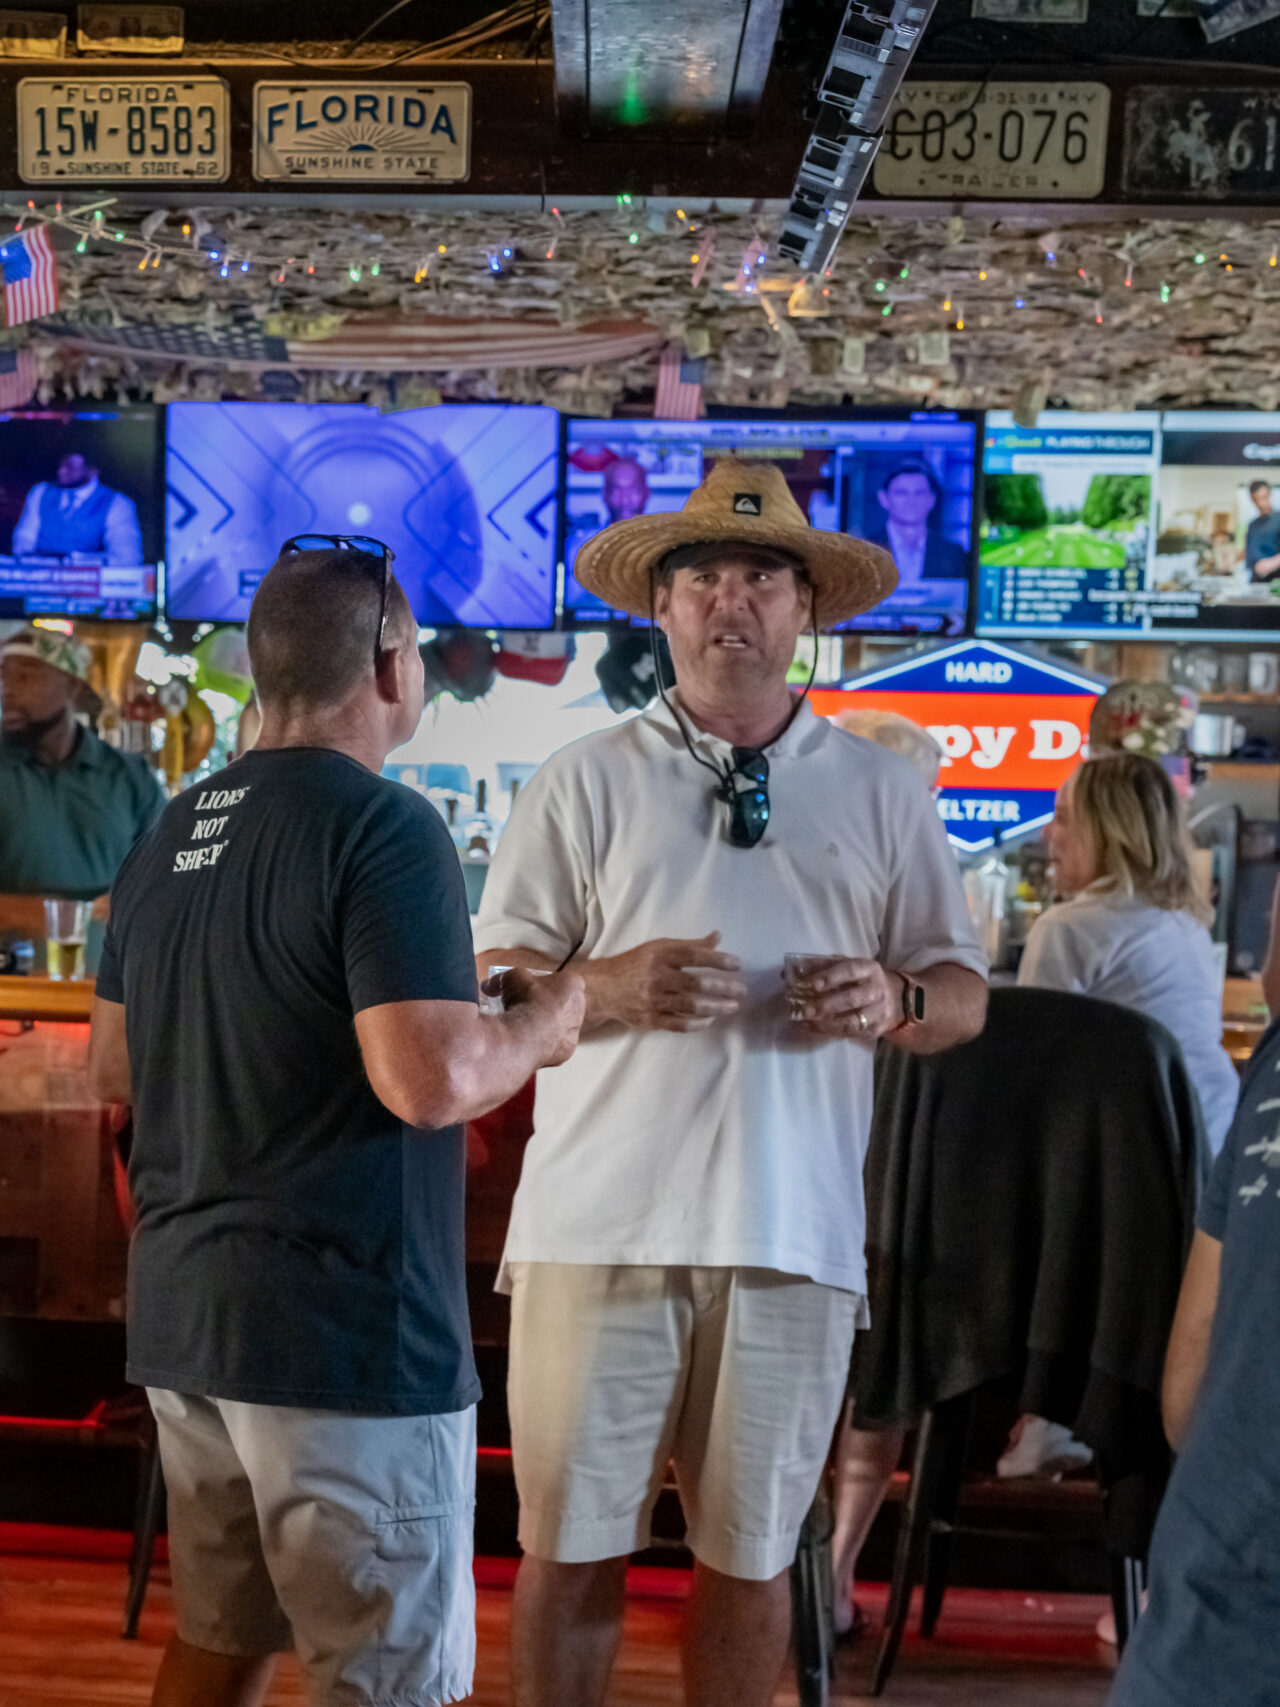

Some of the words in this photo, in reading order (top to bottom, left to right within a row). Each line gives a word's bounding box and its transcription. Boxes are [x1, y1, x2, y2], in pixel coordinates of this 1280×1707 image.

[66, 86, 179, 103] FLORIDA
[34, 105, 216, 157] 15W-8583
[267, 94, 458, 145] FLORIDA
[66, 162, 132, 176] SUNSHINE
[140, 162, 181, 176] STATE
[195, 161, 219, 176] 62
[284, 156, 375, 169] SUNSHINE
[383, 157, 440, 169] STATE
[945, 661, 1013, 683] HARD
[194, 785, 251, 811] LIONS
[936, 798, 1021, 822] ELTZER
[191, 816, 229, 840] NOT
